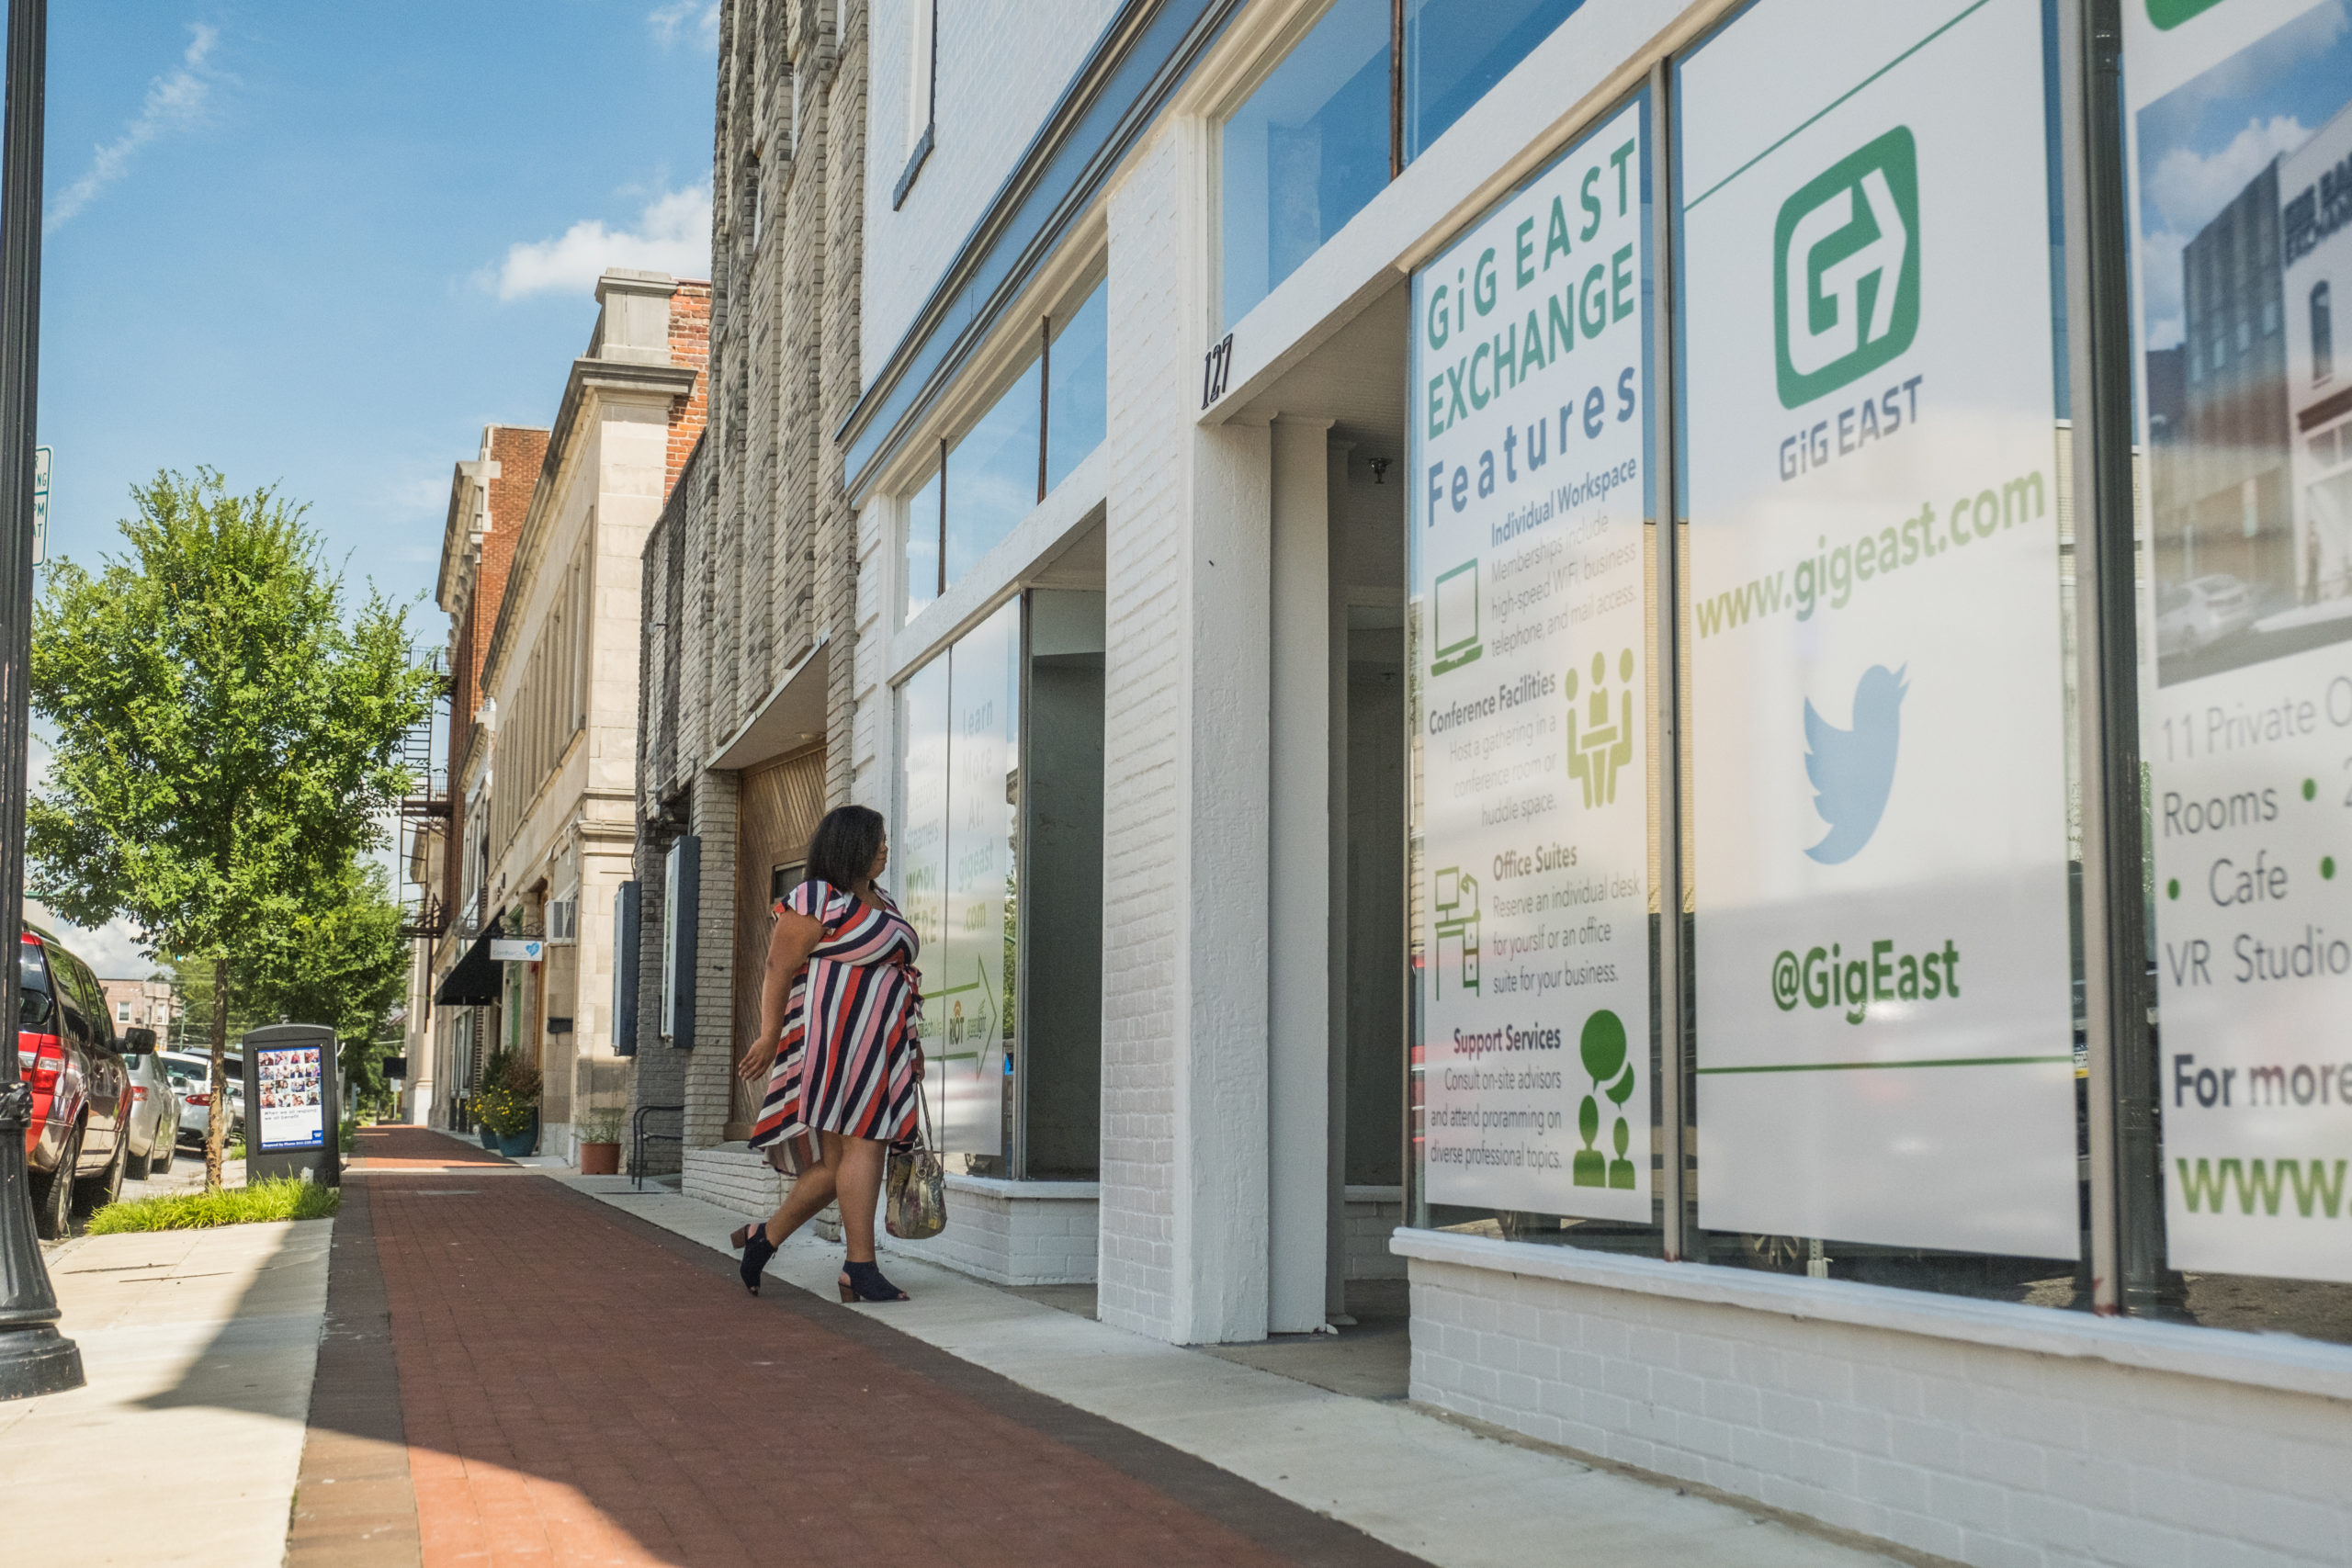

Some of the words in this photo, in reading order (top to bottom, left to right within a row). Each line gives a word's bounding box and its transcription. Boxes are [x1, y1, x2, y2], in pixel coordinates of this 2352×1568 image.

[1427, 246, 1497, 351] GiG
[1516, 137, 1635, 291] EAST
[1428, 242, 1635, 442] EXCHANGE
[1201, 333, 1233, 411] 127
[1428, 366, 1636, 528] Features
[1779, 420, 1829, 482] GiG
[1838, 373, 1924, 458] EAST
[1491, 490, 1555, 547] Individual
[1557, 458, 1636, 513] Workspace
[1491, 536, 1562, 584] Memberships
[1566, 508, 1609, 550] include
[1695, 469, 2045, 639] www.gigeast.com
[1491, 571, 1551, 624] high-speed
[1584, 542, 1636, 580] business
[1547, 603, 1568, 635] and
[1571, 592, 1594, 626] mail
[962, 699, 993, 742] Learn
[1429, 701, 1496, 735] Conference
[1499, 671, 1555, 711] Facilities
[2163, 713, 2194, 762] 11
[2207, 696, 2316, 754] Private
[1450, 740, 1472, 764] Host
[1474, 739, 1480, 758] a
[1483, 721, 1533, 761] gathering
[1536, 713, 1546, 736] in
[1549, 715, 1556, 733] a
[1453, 768, 1510, 798] conference
[1512, 757, 1542, 781] room
[1544, 753, 1557, 773] or
[1482, 795, 1519, 827] huddle
[2164, 788, 2278, 837] Rooms
[1493, 849, 1532, 881] Office
[1535, 841, 1577, 874] Suites
[2209, 849, 2288, 907] Cafe
[1493, 896, 1533, 919] Reserve
[1536, 893, 1550, 912] an
[1552, 874, 1607, 908] individual
[1611, 869, 1640, 899] desk
[1493, 931, 1507, 956] for
[1547, 930, 1560, 949] or
[1562, 927, 1576, 947] an
[1579, 916, 1611, 944] office
[2165, 939, 2212, 987] VR
[2234, 924, 2351, 983] Studio
[1493, 969, 1518, 994] suite
[1520, 964, 1535, 991] for
[1536, 970, 1563, 997] your
[1772, 939, 1960, 1025] @GigEast
[1453, 1027, 1503, 1061] Support
[1506, 1021, 1561, 1052] Services
[1444, 1065, 1480, 1091] Consult
[1482, 1066, 1515, 1091] on-site
[1518, 1064, 1562, 1089] advisors
[2174, 1054, 2236, 1108] For
[1430, 1102, 1448, 1128] and
[1451, 1102, 1479, 1128] attend
[1547, 1111, 1562, 1129] on
[1430, 1139, 1464, 1164] diverse
[1464, 1140, 1525, 1171] professional
